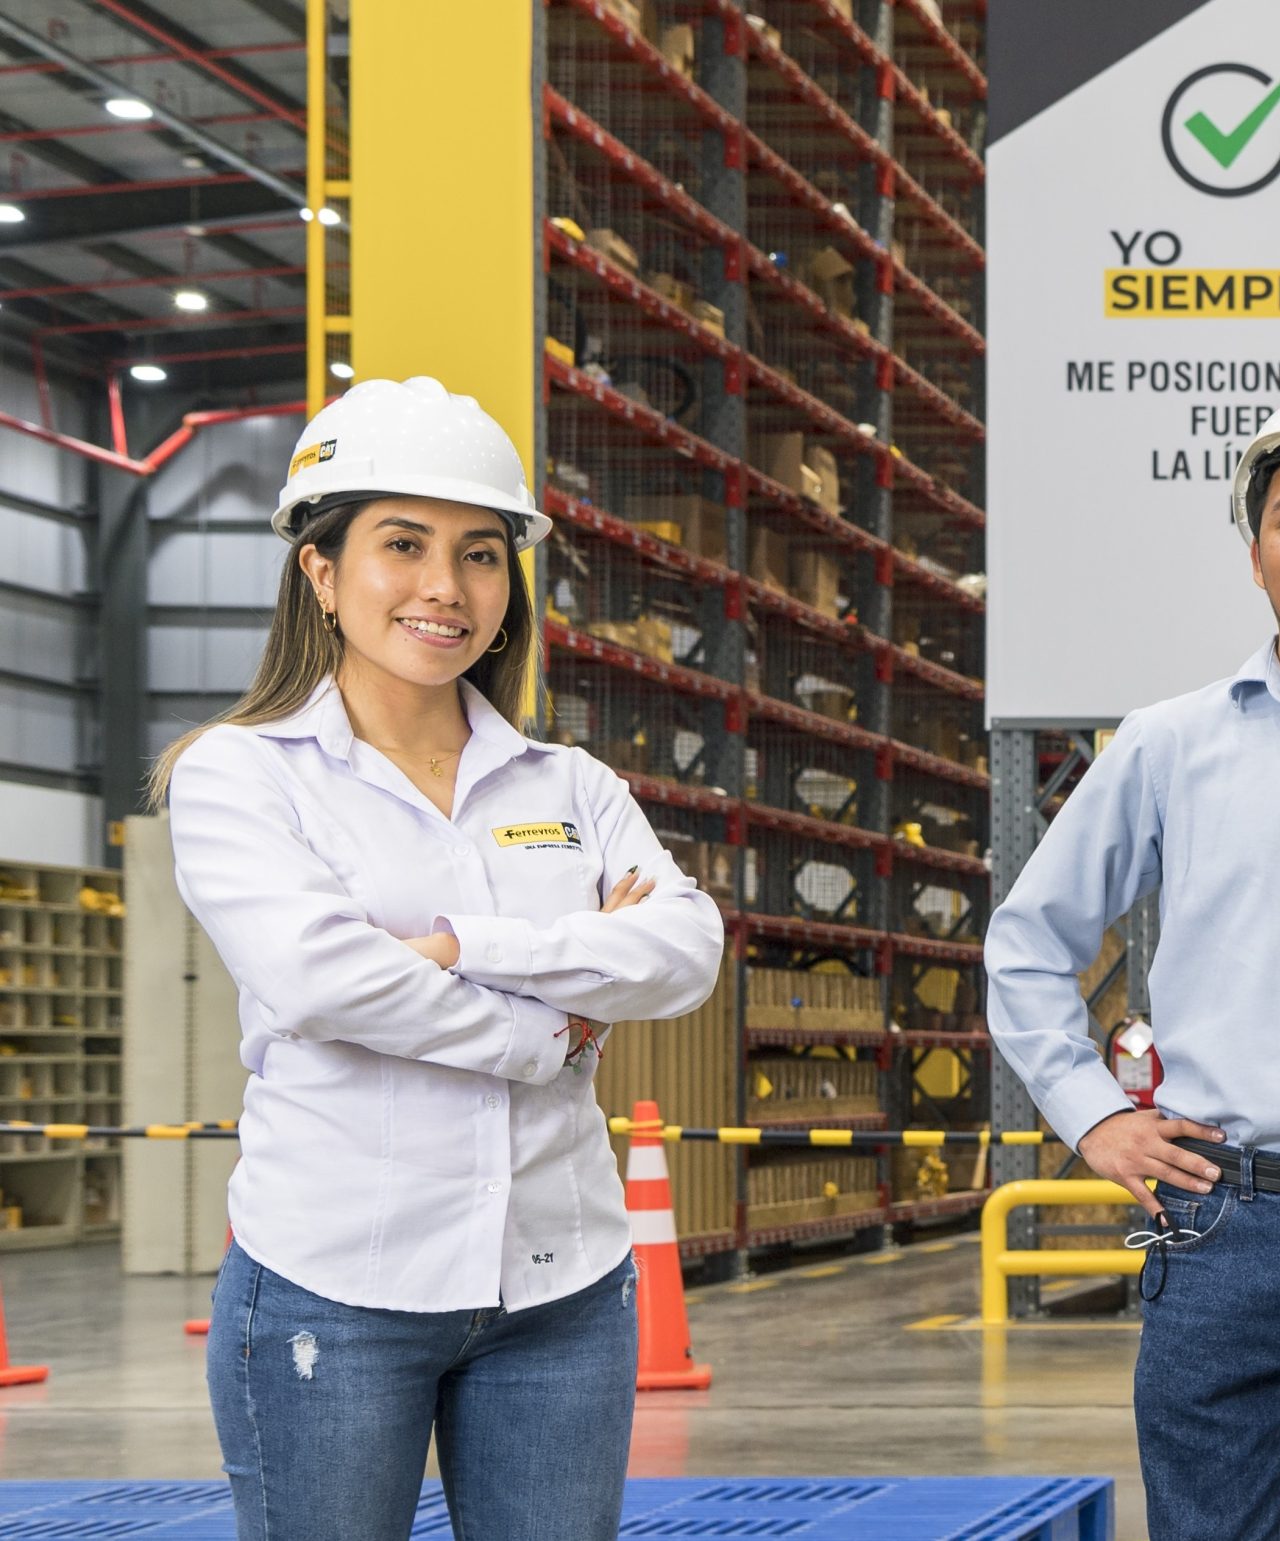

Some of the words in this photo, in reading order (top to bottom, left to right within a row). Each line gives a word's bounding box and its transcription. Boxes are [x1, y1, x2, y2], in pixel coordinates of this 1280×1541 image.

[1110, 230, 1182, 267] YO
[1066, 361, 1115, 392] ME
[1152, 449, 1192, 480] LA
